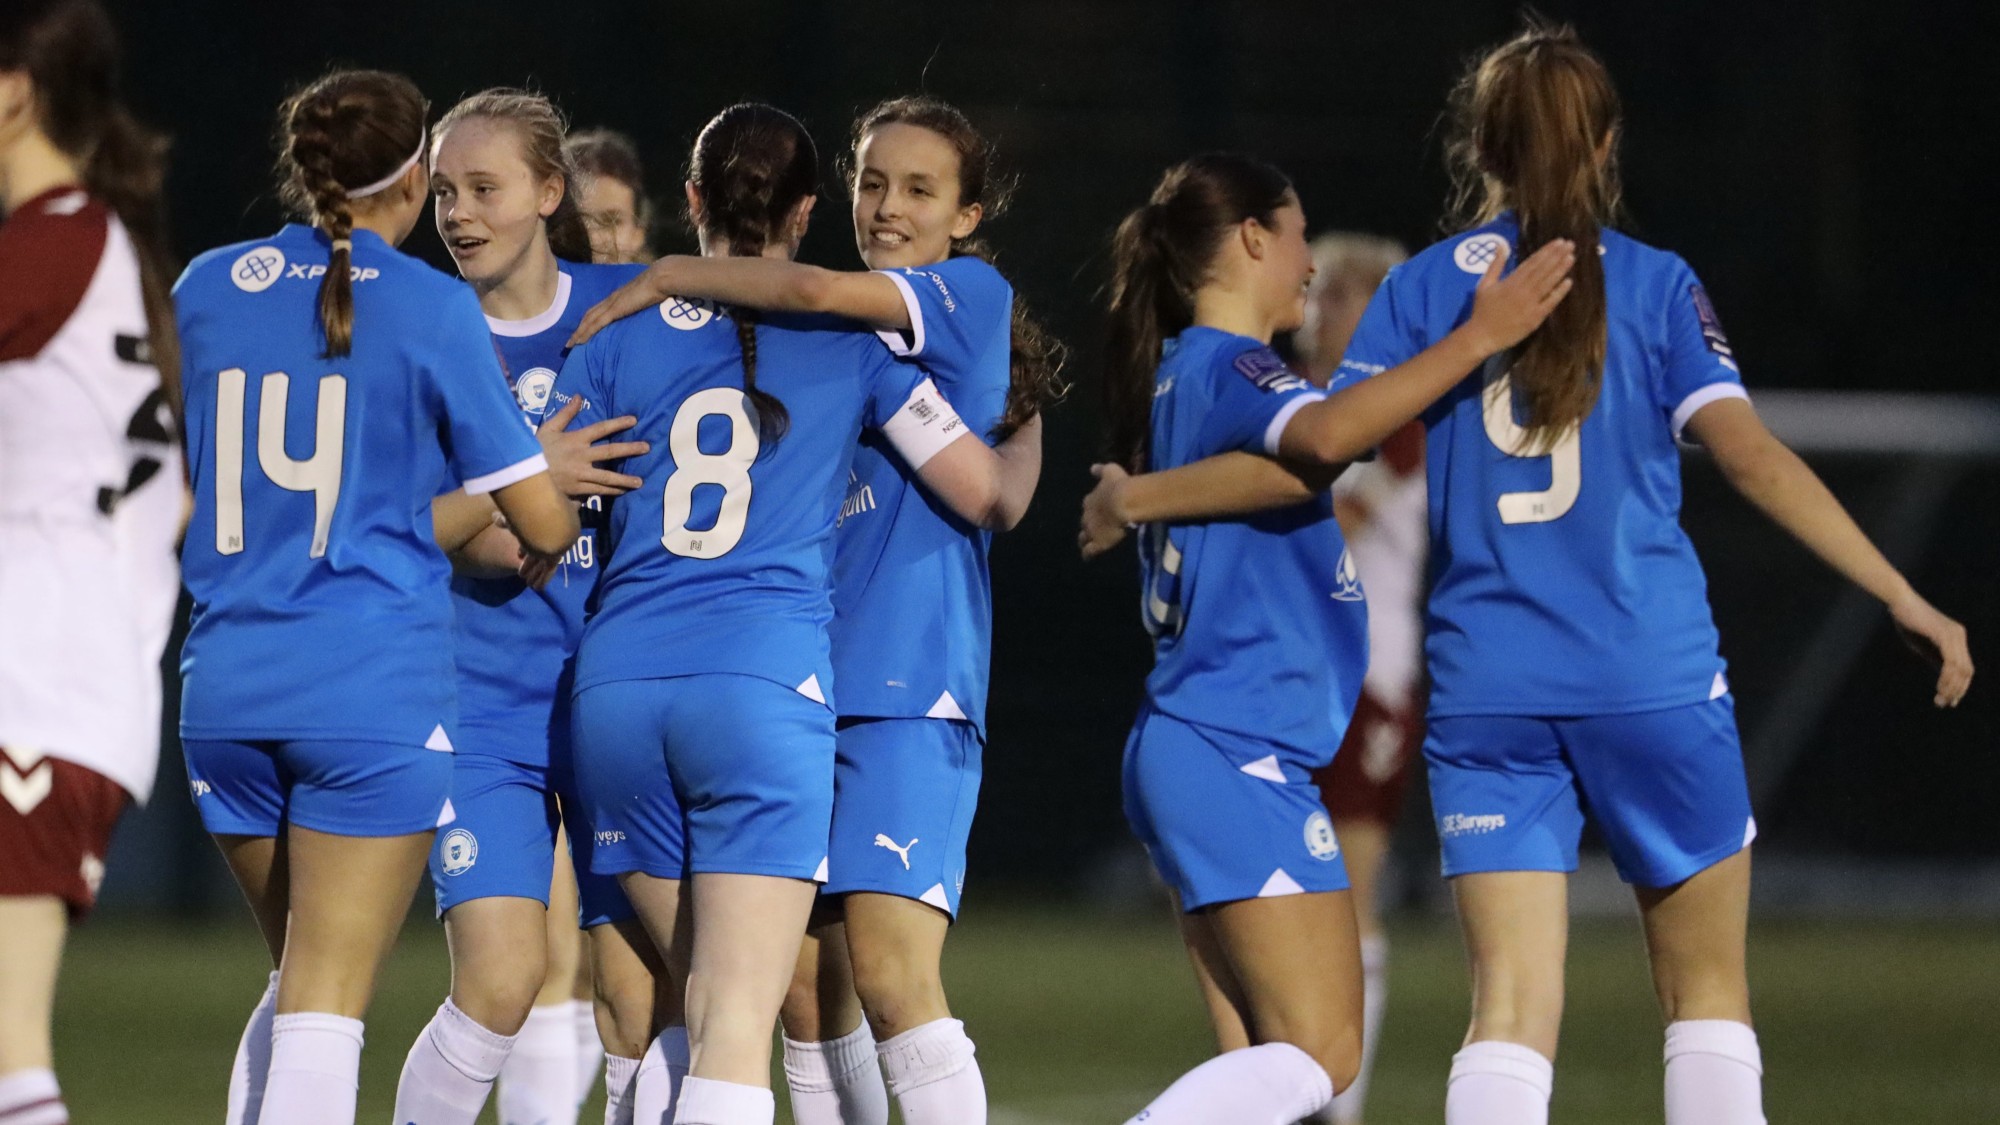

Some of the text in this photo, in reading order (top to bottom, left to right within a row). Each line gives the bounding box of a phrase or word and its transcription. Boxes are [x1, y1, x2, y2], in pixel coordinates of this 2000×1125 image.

[286, 262, 380, 282] XPOP
[215, 367, 347, 559] 14
[660, 386, 760, 560] 8
